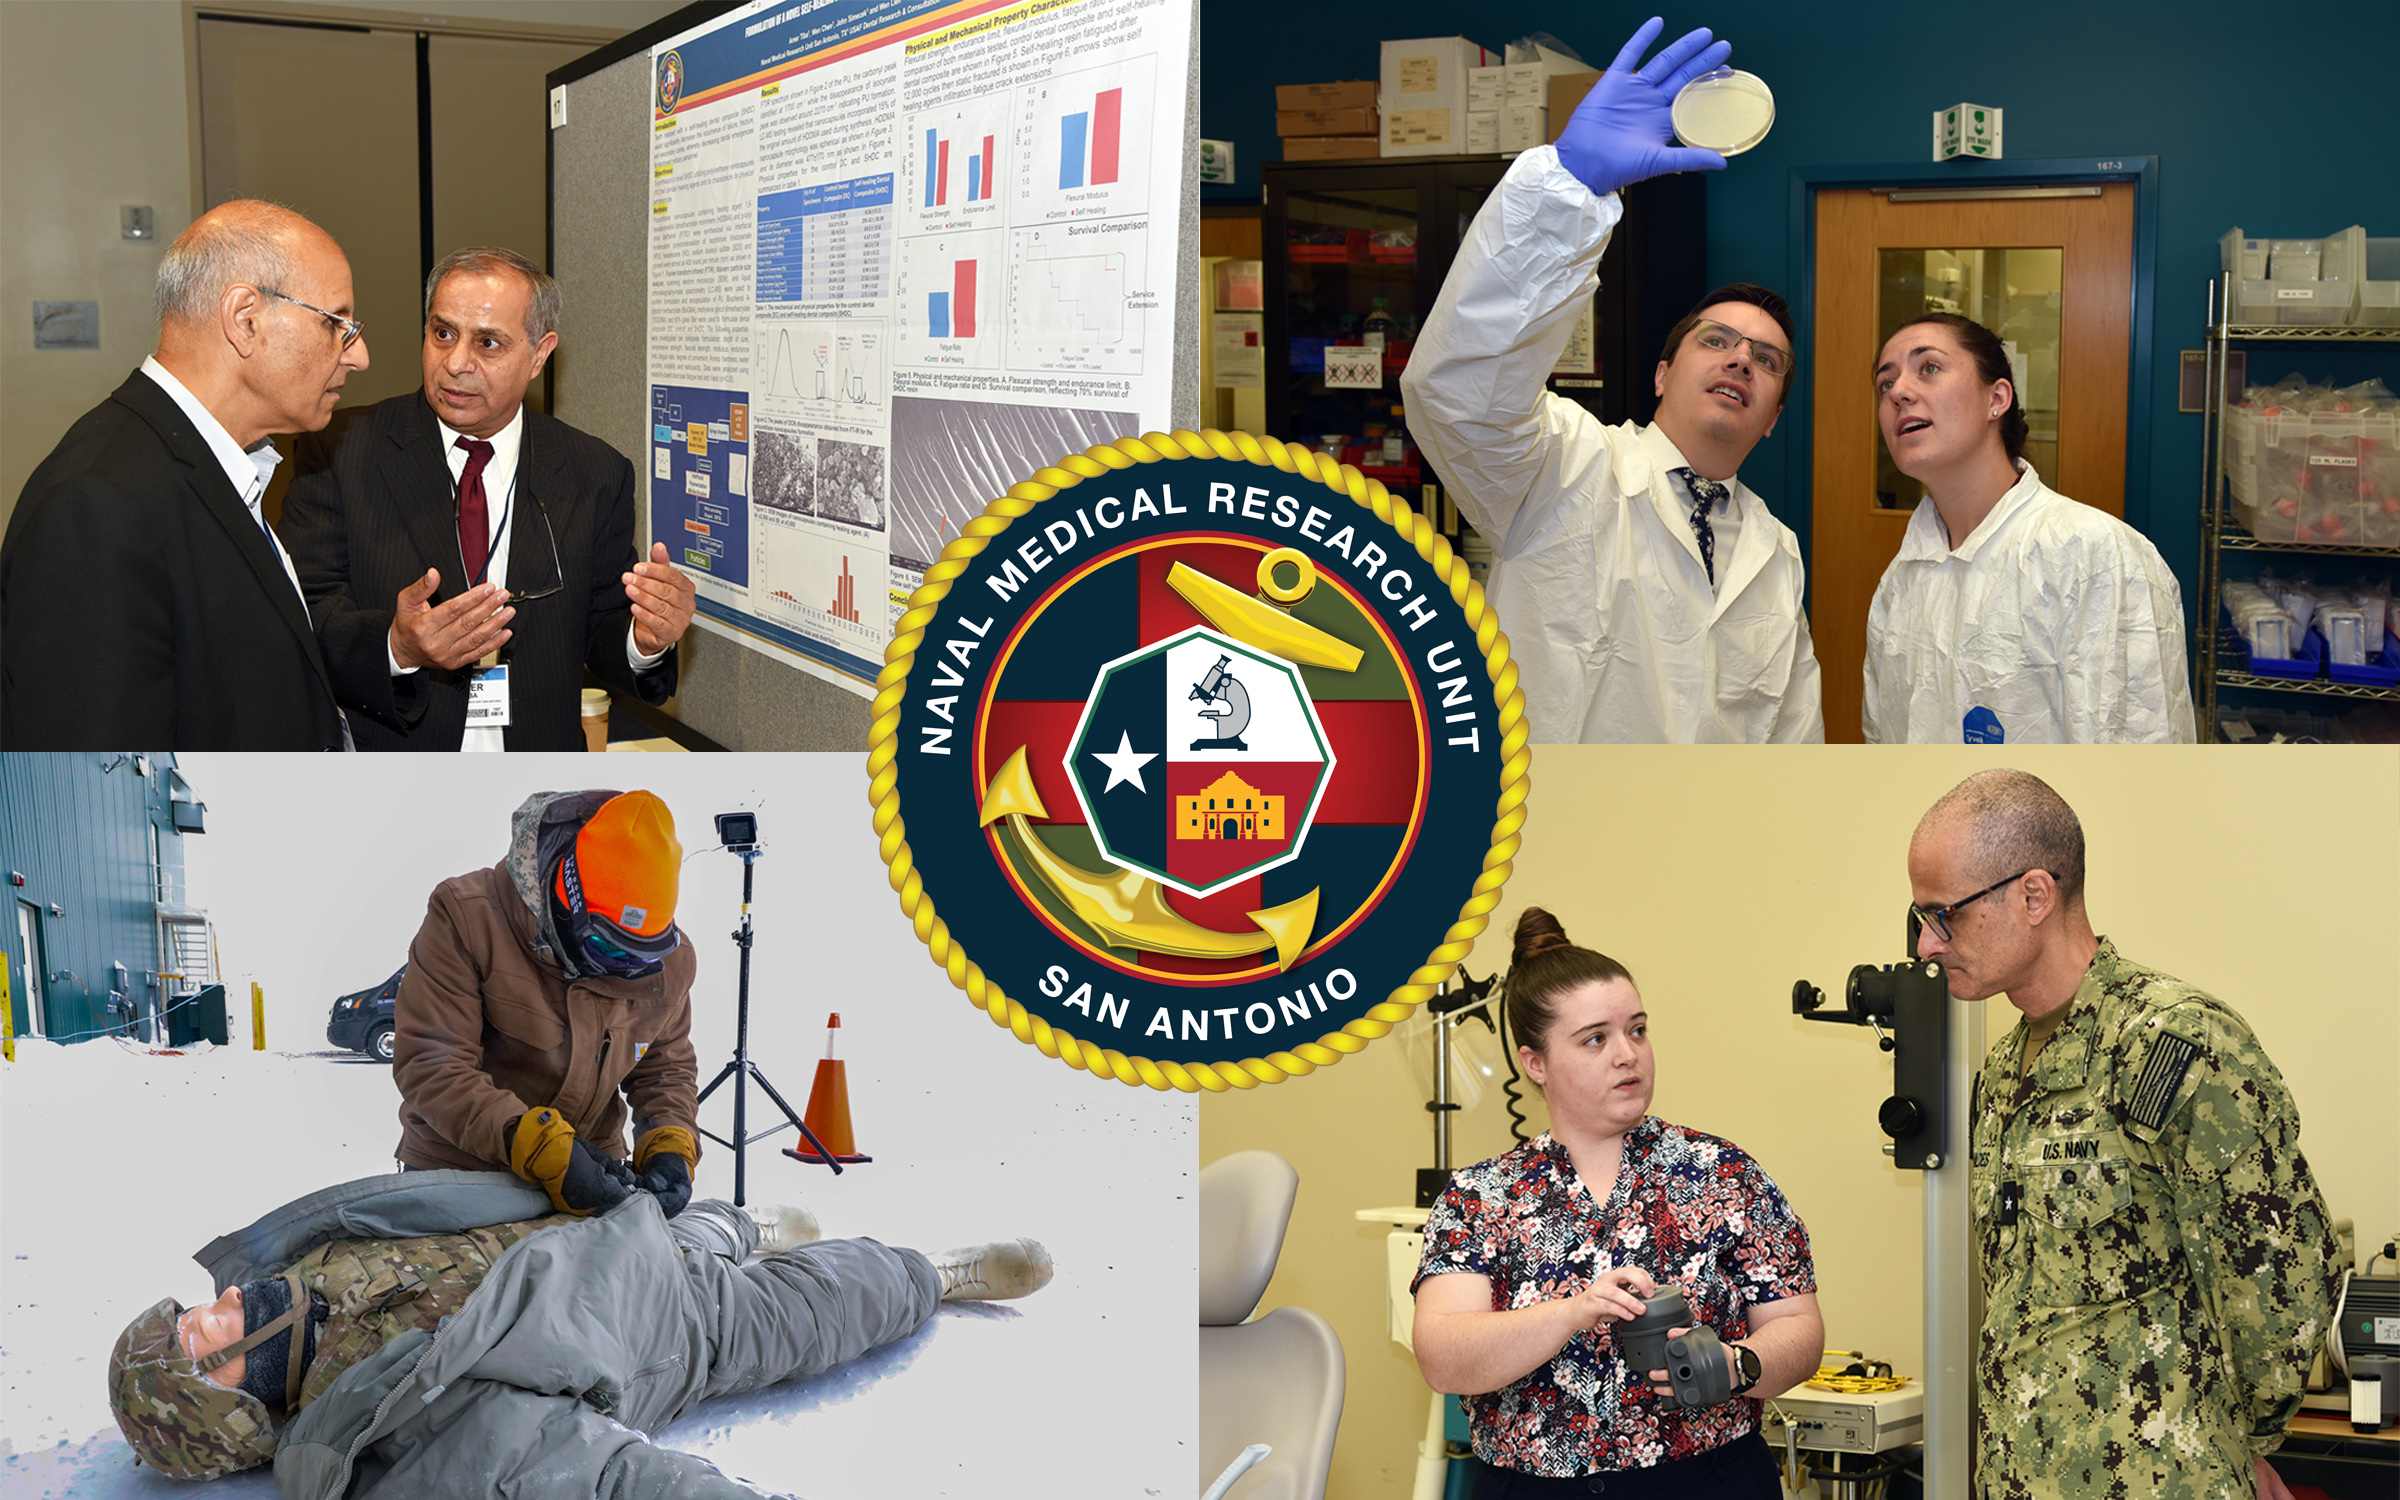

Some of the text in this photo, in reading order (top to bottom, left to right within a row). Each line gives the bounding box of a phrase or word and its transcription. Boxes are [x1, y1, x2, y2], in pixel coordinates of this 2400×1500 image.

[745, 17, 775, 38] FORMULATION
[776, 14, 781, 26] OF
[785, 6, 800, 21] NOVEL
[786, 44, 804, 56] Research
[805, 41, 813, 50] Unit
[814, 39, 822, 47] San
[849, 24, 862, 34] USAF
[863, 18, 877, 29] Dental
[878, 10, 900, 24] Research
[904, 52, 925, 65] Flexural
[953, 36, 985, 50] endurance
[1004, 21, 1027, 35] flexural
[1062, 4, 1087, 17] fatigue
[905, 8, 1027, 53] Physical and Mechanical Property
[903, 62, 934, 76] comparison
[936, 58, 942, 67] of
[943, 54, 956, 65] both
[958, 46, 985, 61] materials
[1010, 32, 1032, 46] control
[1033, 25, 1056, 39] dental
[1057, 15, 1094, 32] composite
[1096, 8, 1113, 20] and
[903, 76, 920, 88] dental
[920, 69, 949, 84] composite
[951, 67, 961, 75] are
[962, 62, 982, 72] shown
[983, 58, 989, 67] in
[991, 53, 1011, 65] Figure
[1020, 38, 1062, 56] Self-healing
[1064, 32, 1081, 43] resin
[1082, 20, 1117, 38] fatigued
[1118, 16, 1138, 28] after
[922, 84, 940, 96] cycles
[941, 80, 955, 90] then
[956, 75, 971, 86] static
[972, 66, 1000, 82] fractured
[1001, 65, 1007, 74] is
[1008, 61, 1031, 72] shown
[1032, 57, 1039, 66] in
[1041, 52, 1063, 64] Figure
[1072, 42, 1100, 55] arrows
[1102, 36, 1124, 47] show
[1126, 28, 1142, 41] self
[761, 86, 779, 97] Results
[903, 100, 922, 111] healing
[922, 95, 941, 107] agents
[943, 88, 971, 101] infiltration
[972, 83, 994, 93] fatigue
[995, 76, 1013, 88] crack
[1042, 90, 1047, 99] B
[553, 99, 561, 115] 17
[956, 112, 961, 120] A
[1966, 135, 1992, 146] EYE WASH
[2097, 161, 2123, 170] 167-3
[1065, 191, 1109, 203] Flexural Modulus
[962, 206, 984, 215] Endurance
[1050, 206, 1106, 219] Control Self Healing
[1068, 220, 1148, 237] Survival Comparison
[1034, 232, 1040, 241] D
[1132, 290, 1155, 299] Service
[1128, 301, 1158, 310] Extension
[892, 371, 906, 380] Figure
[912, 371, 932, 380] Physical
[1008, 376, 1031, 384] Flexural
[1032, 377, 1056, 387] strength
[1071, 379, 1104, 387] endurance
[892, 377, 910, 385] Flexural
[939, 380, 958, 389] Fatigue
[989, 383, 1010, 391] Survival
[1048, 387, 1077, 397] reflecting
[890, 570, 904, 579] Figure
[889, 592, 908, 604] Concl
[470, 683, 484, 691] ER
[564, 857, 578, 915] MASTER
[2042, 1140, 2099, 1160] U.S. NAVY
